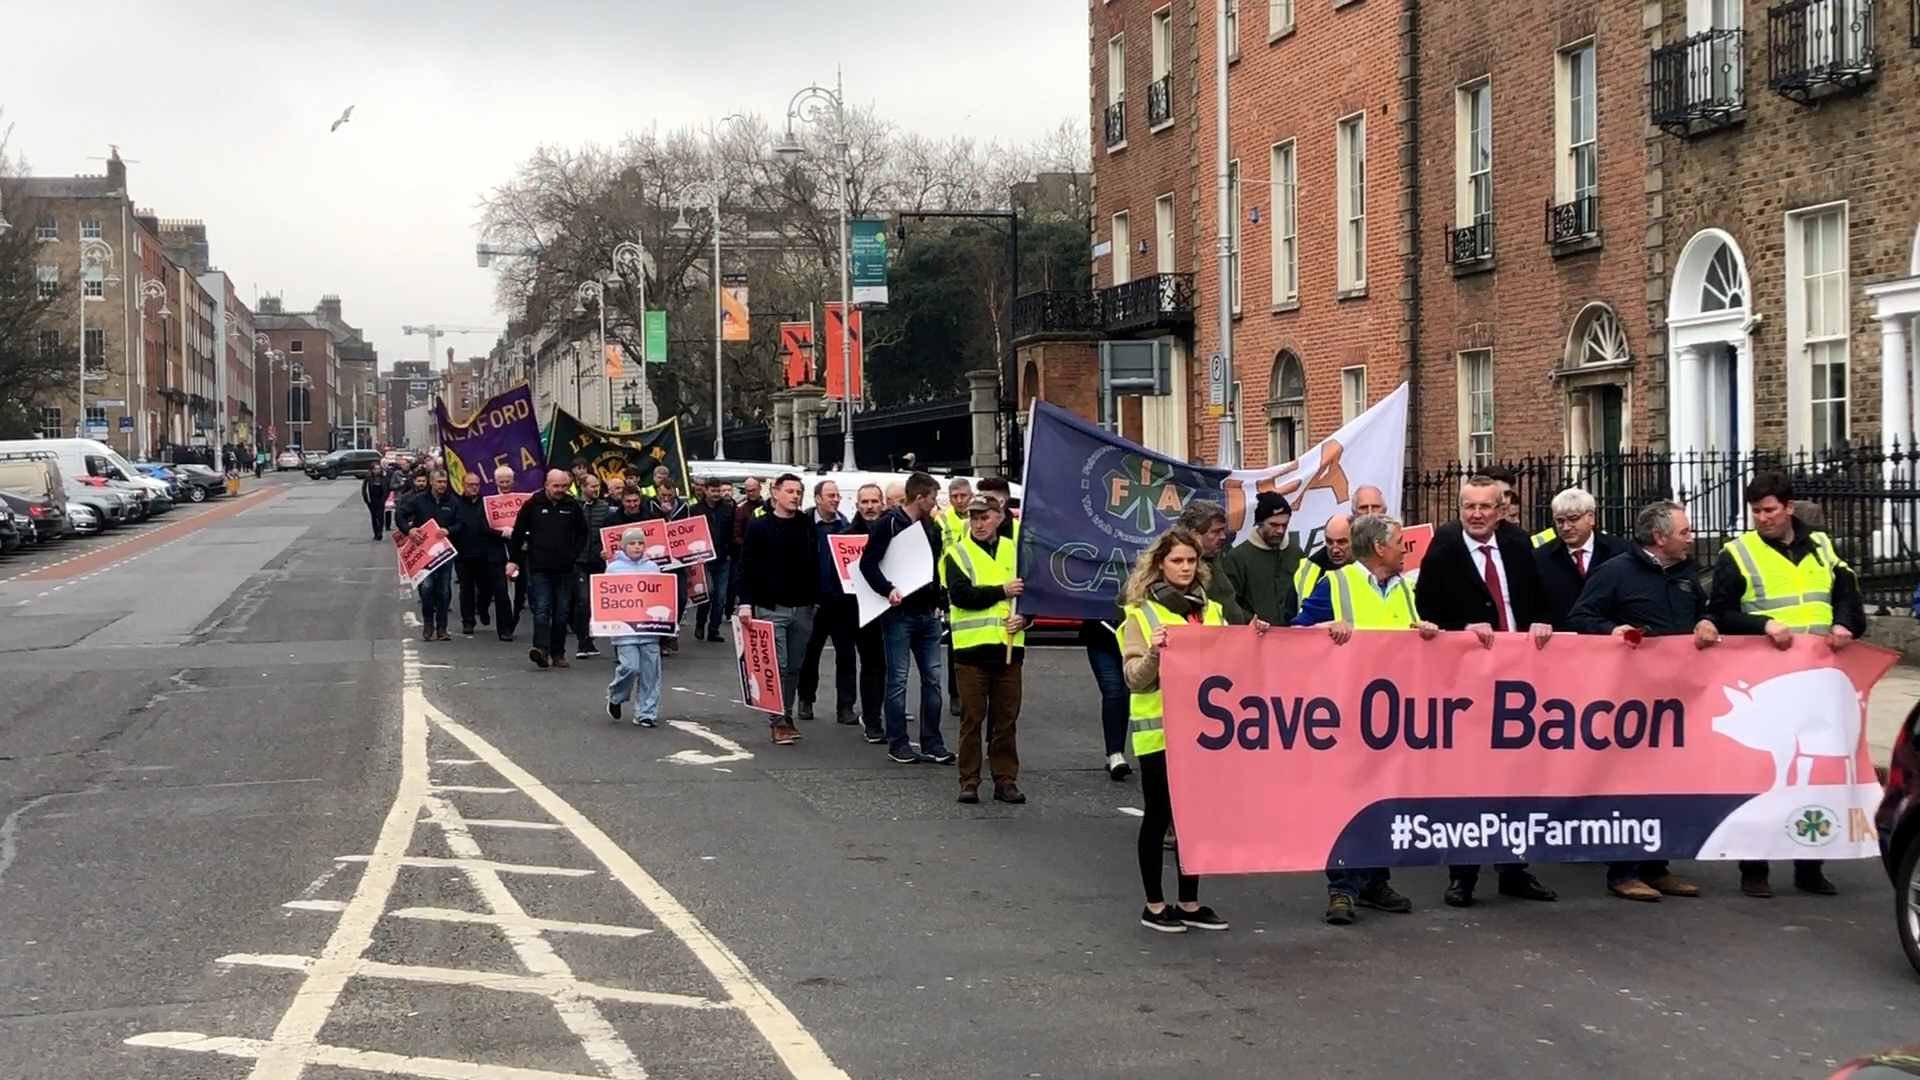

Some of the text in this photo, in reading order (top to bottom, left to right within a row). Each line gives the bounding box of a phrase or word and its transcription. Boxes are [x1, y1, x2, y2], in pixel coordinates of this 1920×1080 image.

[492, 510, 516, 521] Baco
[606, 527, 655, 543] Sa ur
[677, 524, 696, 536] Our
[669, 539, 686, 550] con
[1401, 540, 1417, 554] ur
[600, 580, 662, 594] Save Our
[600, 596, 644, 609] Bacon
[749, 628, 761, 673] Bacon
[759, 629, 775, 697] Save Our
[1196, 674, 1685, 751] Save Our Bacon
[1390, 810, 1661, 855] #SavePigFarming
